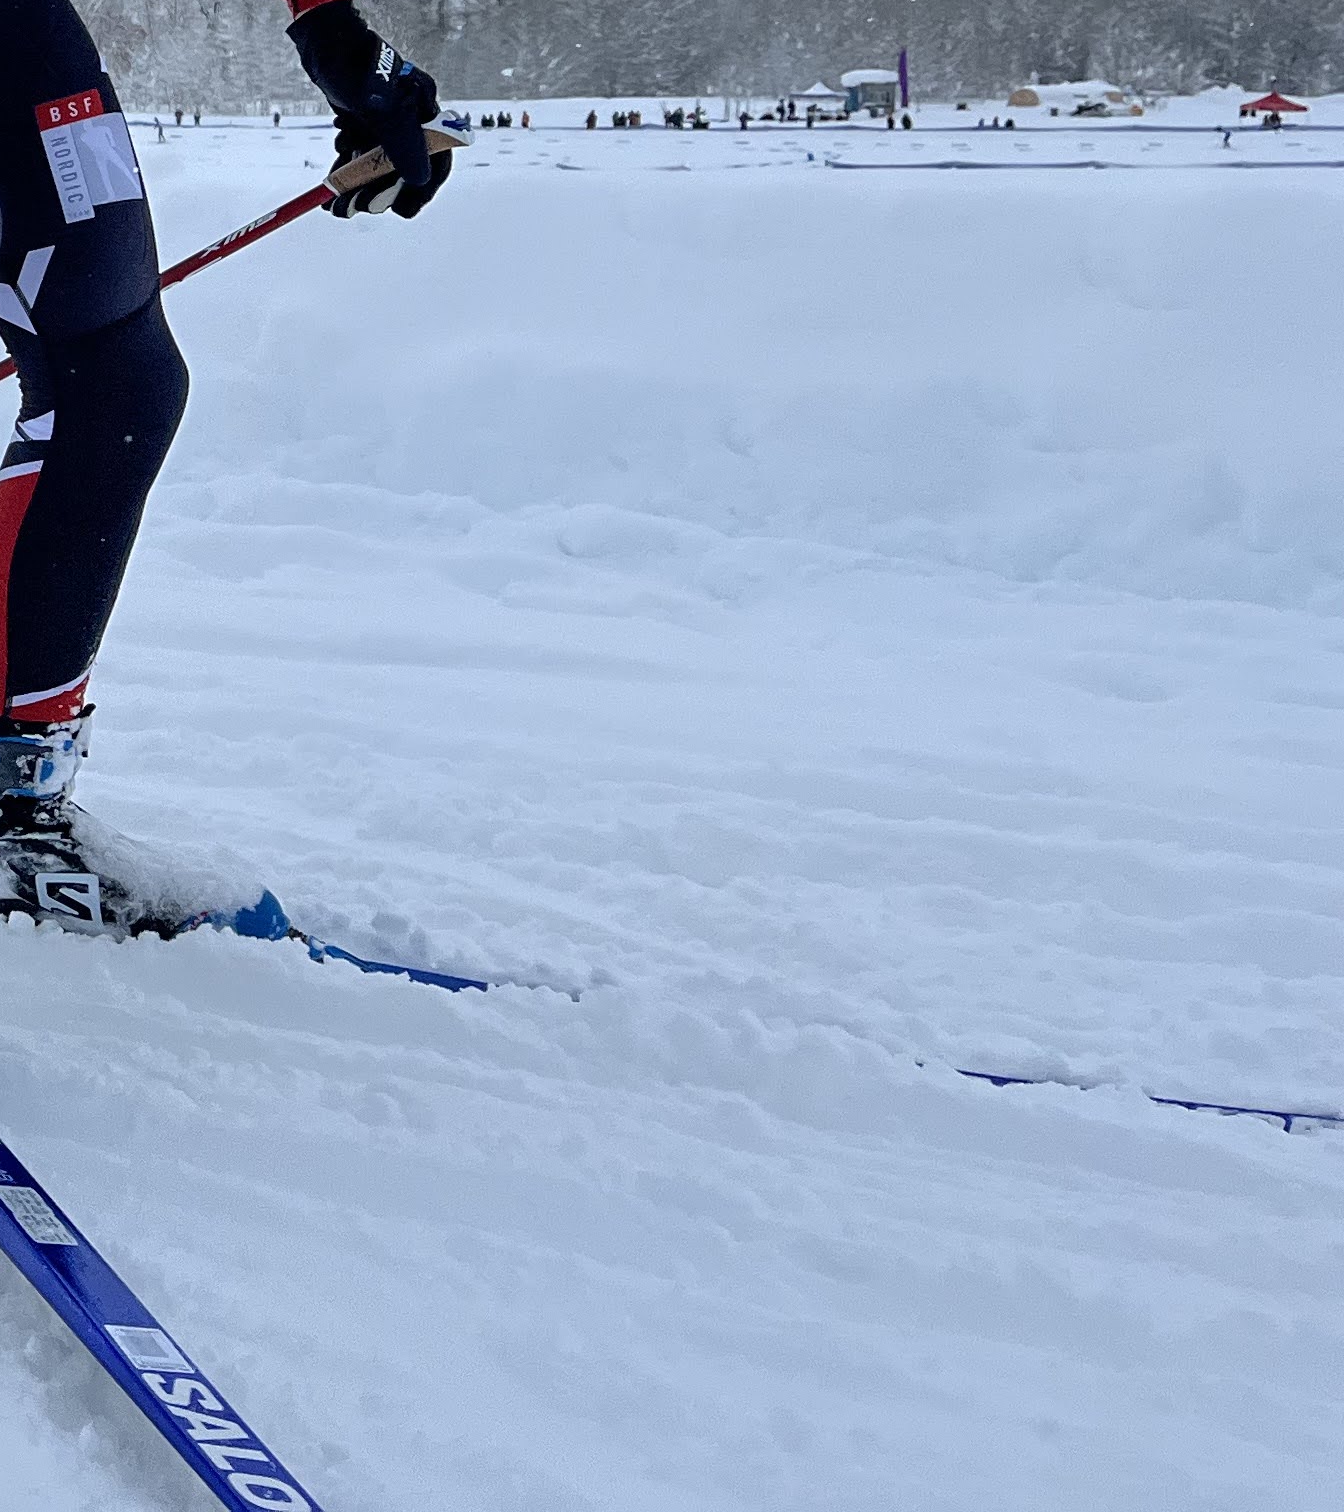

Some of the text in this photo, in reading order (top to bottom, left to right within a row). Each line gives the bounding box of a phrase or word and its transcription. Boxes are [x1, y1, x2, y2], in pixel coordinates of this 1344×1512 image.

[49, 96, 92, 123] BSF
[50, 135, 84, 204] NORDIC
[141, 1372, 312, 1512] SALO
